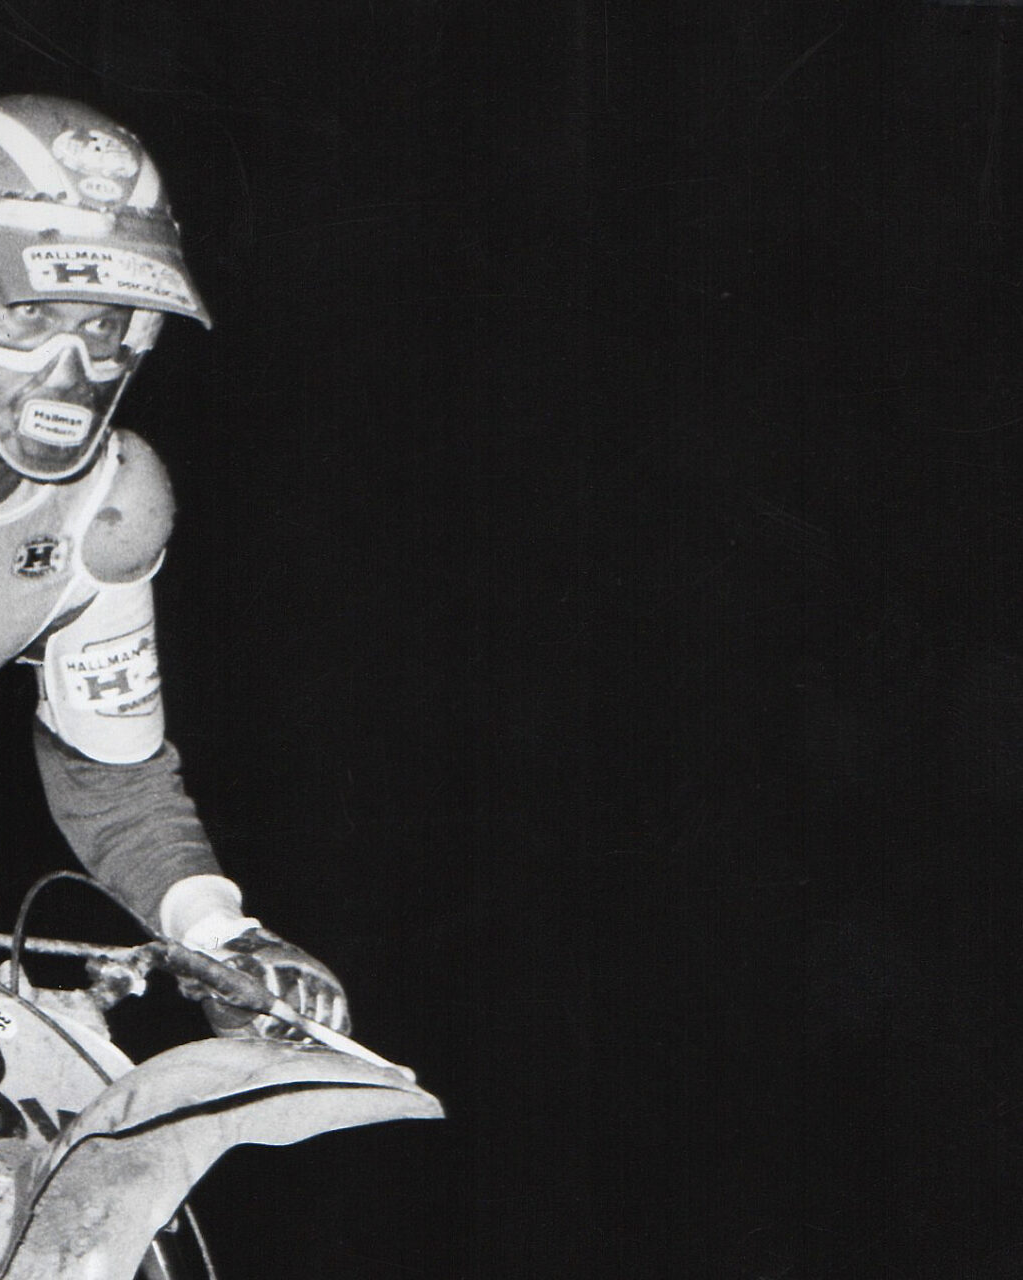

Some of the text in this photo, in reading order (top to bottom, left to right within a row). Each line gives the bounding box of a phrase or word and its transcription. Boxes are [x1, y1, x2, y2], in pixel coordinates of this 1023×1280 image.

[30, 251, 113, 263] HALLMAN
[54, 264, 101, 284] H
[66, 649, 140, 671] HALLMAN
[82, 667, 134, 701] H
